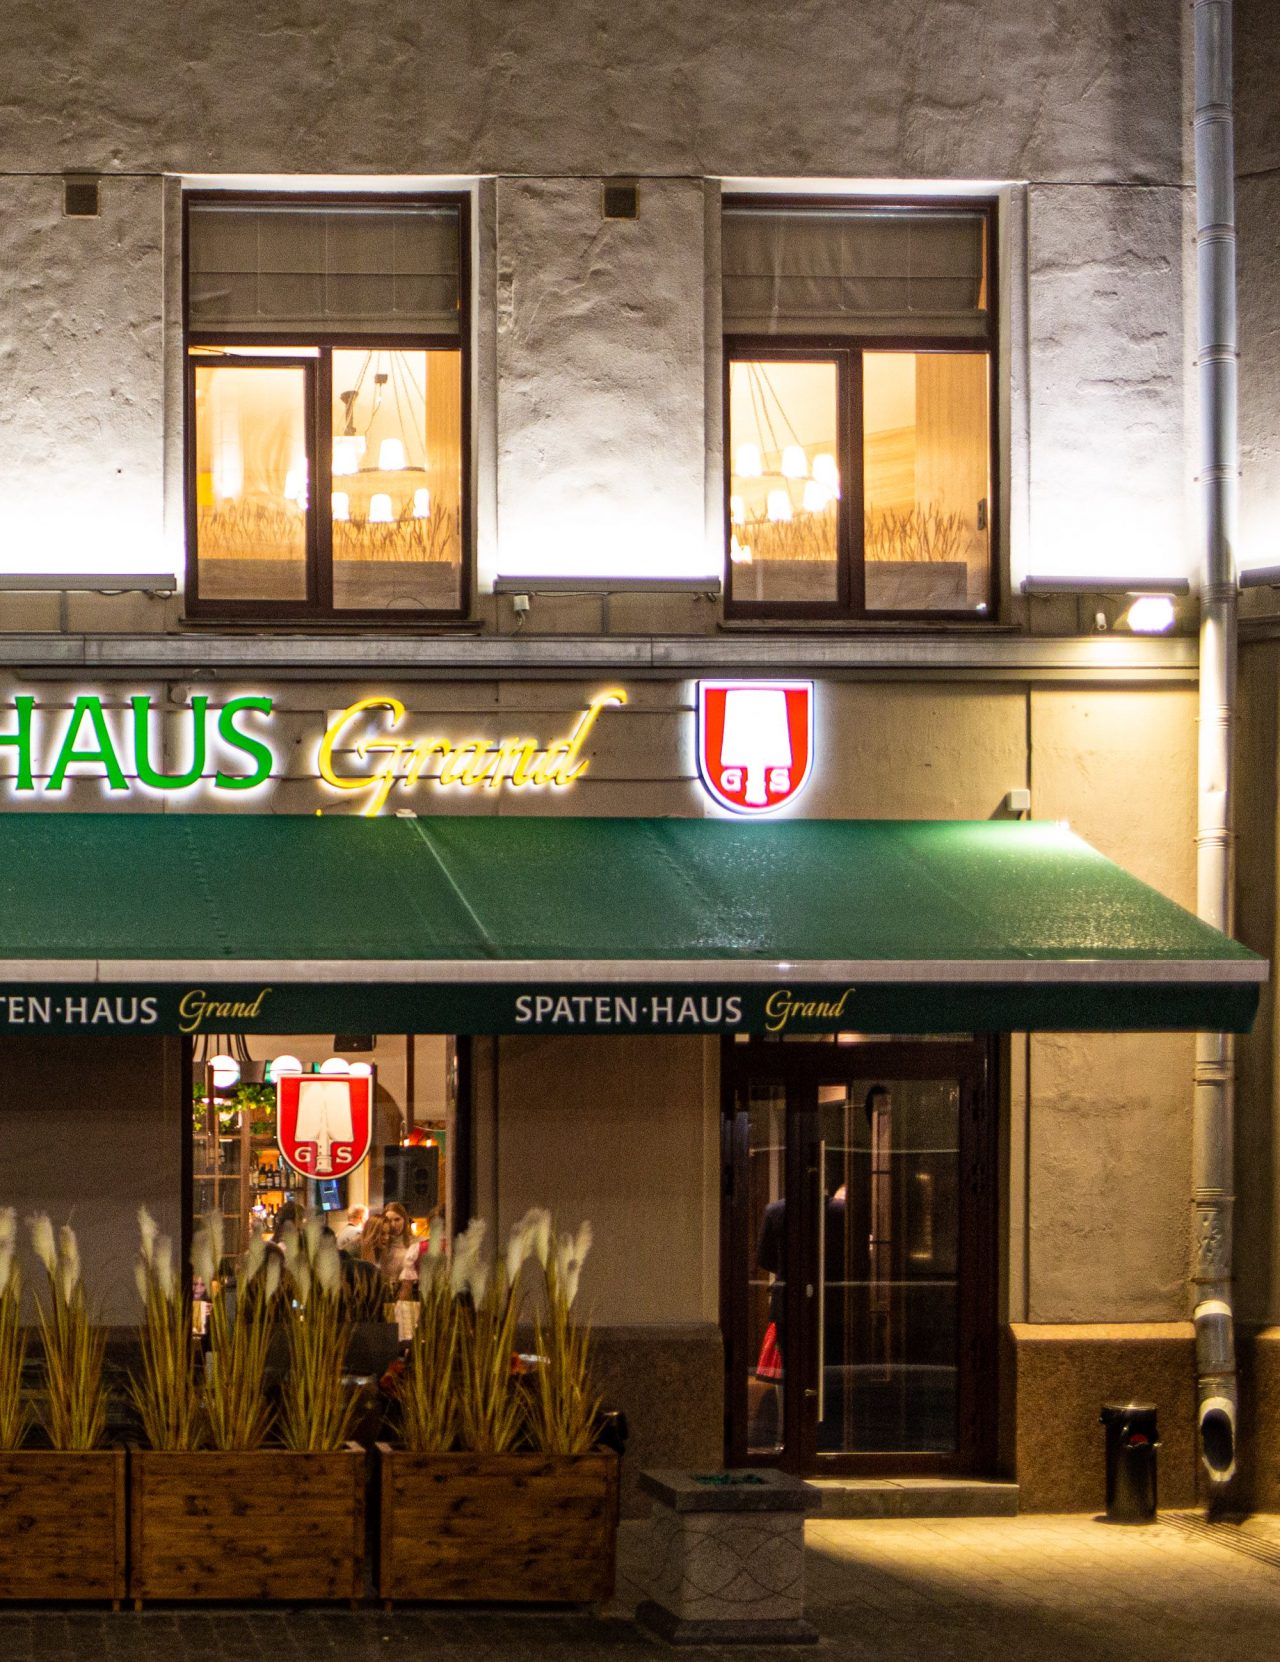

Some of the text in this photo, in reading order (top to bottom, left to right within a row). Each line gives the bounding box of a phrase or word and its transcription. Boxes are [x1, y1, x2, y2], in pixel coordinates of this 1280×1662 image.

[317, 688, 628, 817] Grand
[720, 768, 791, 793] G S
[178, 988, 272, 1033] Grand
[764, 988, 856, 1032] Grand
[294, 1146, 352, 1163] G S
